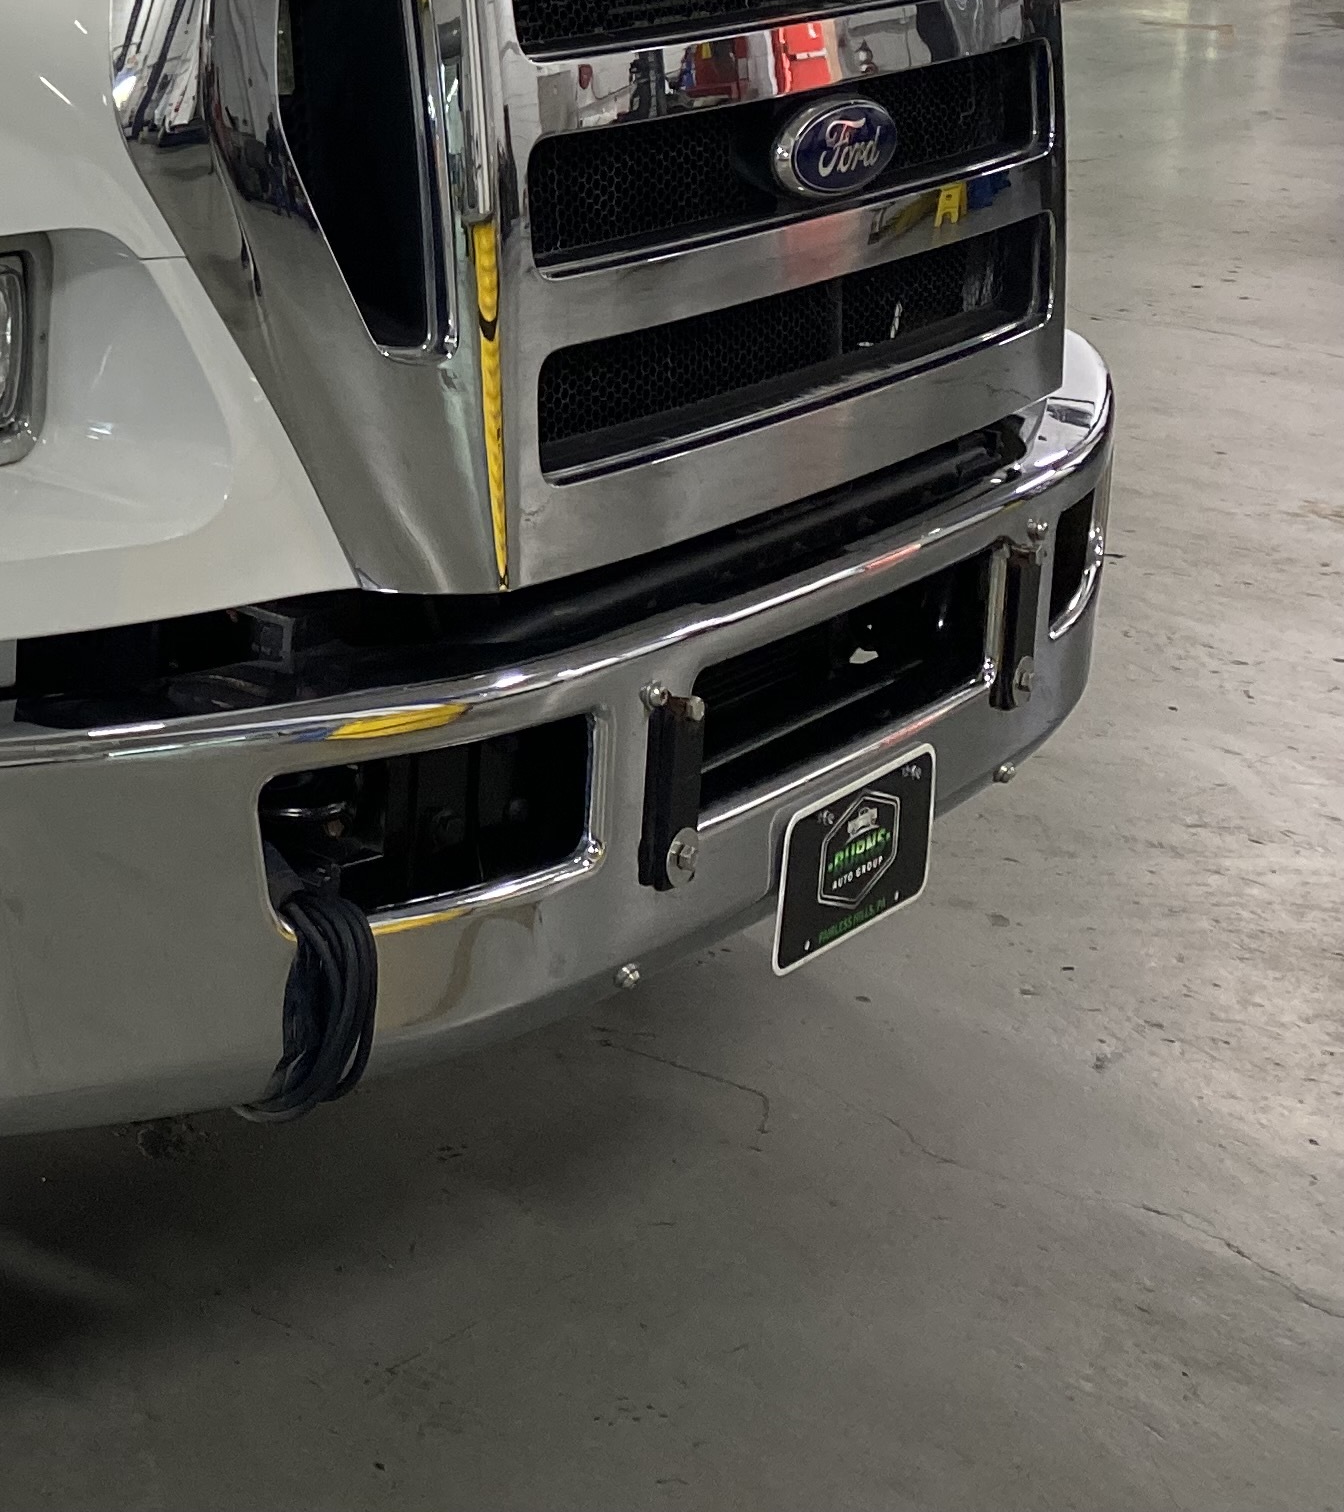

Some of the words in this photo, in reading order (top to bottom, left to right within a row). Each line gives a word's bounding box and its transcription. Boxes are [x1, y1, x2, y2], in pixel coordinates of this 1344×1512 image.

[818, 117, 881, 178] Ford
[832, 871, 854, 890] AUTO
[855, 855, 883, 878] GROUP
